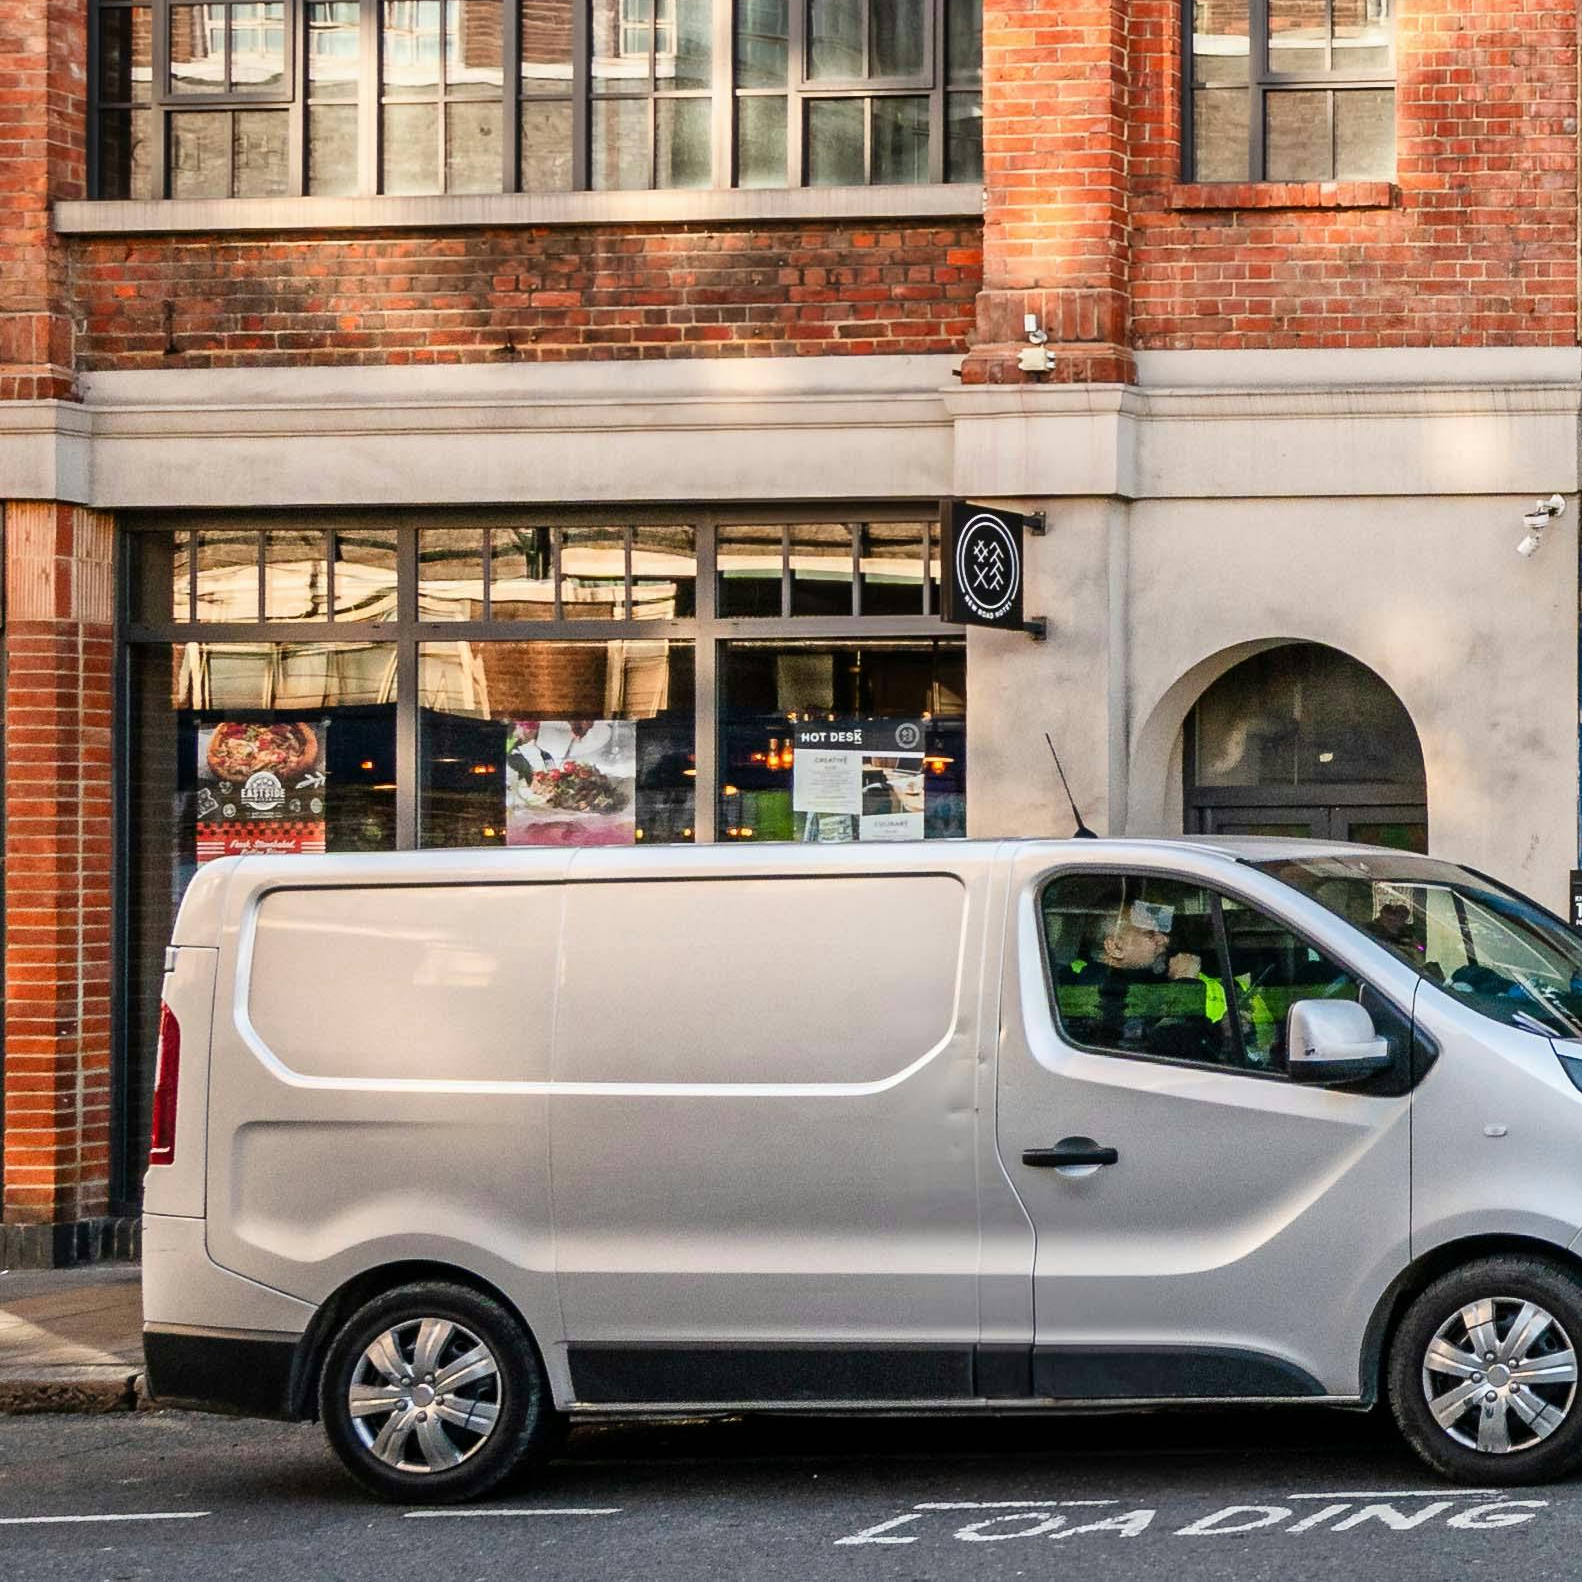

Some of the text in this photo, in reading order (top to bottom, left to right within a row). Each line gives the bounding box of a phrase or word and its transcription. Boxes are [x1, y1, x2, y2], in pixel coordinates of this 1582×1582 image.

[800, 729, 862, 744] HOT DESK
[241, 788, 286, 798] EASTSIDE
[833, 1500, 1549, 1545] LOADING
